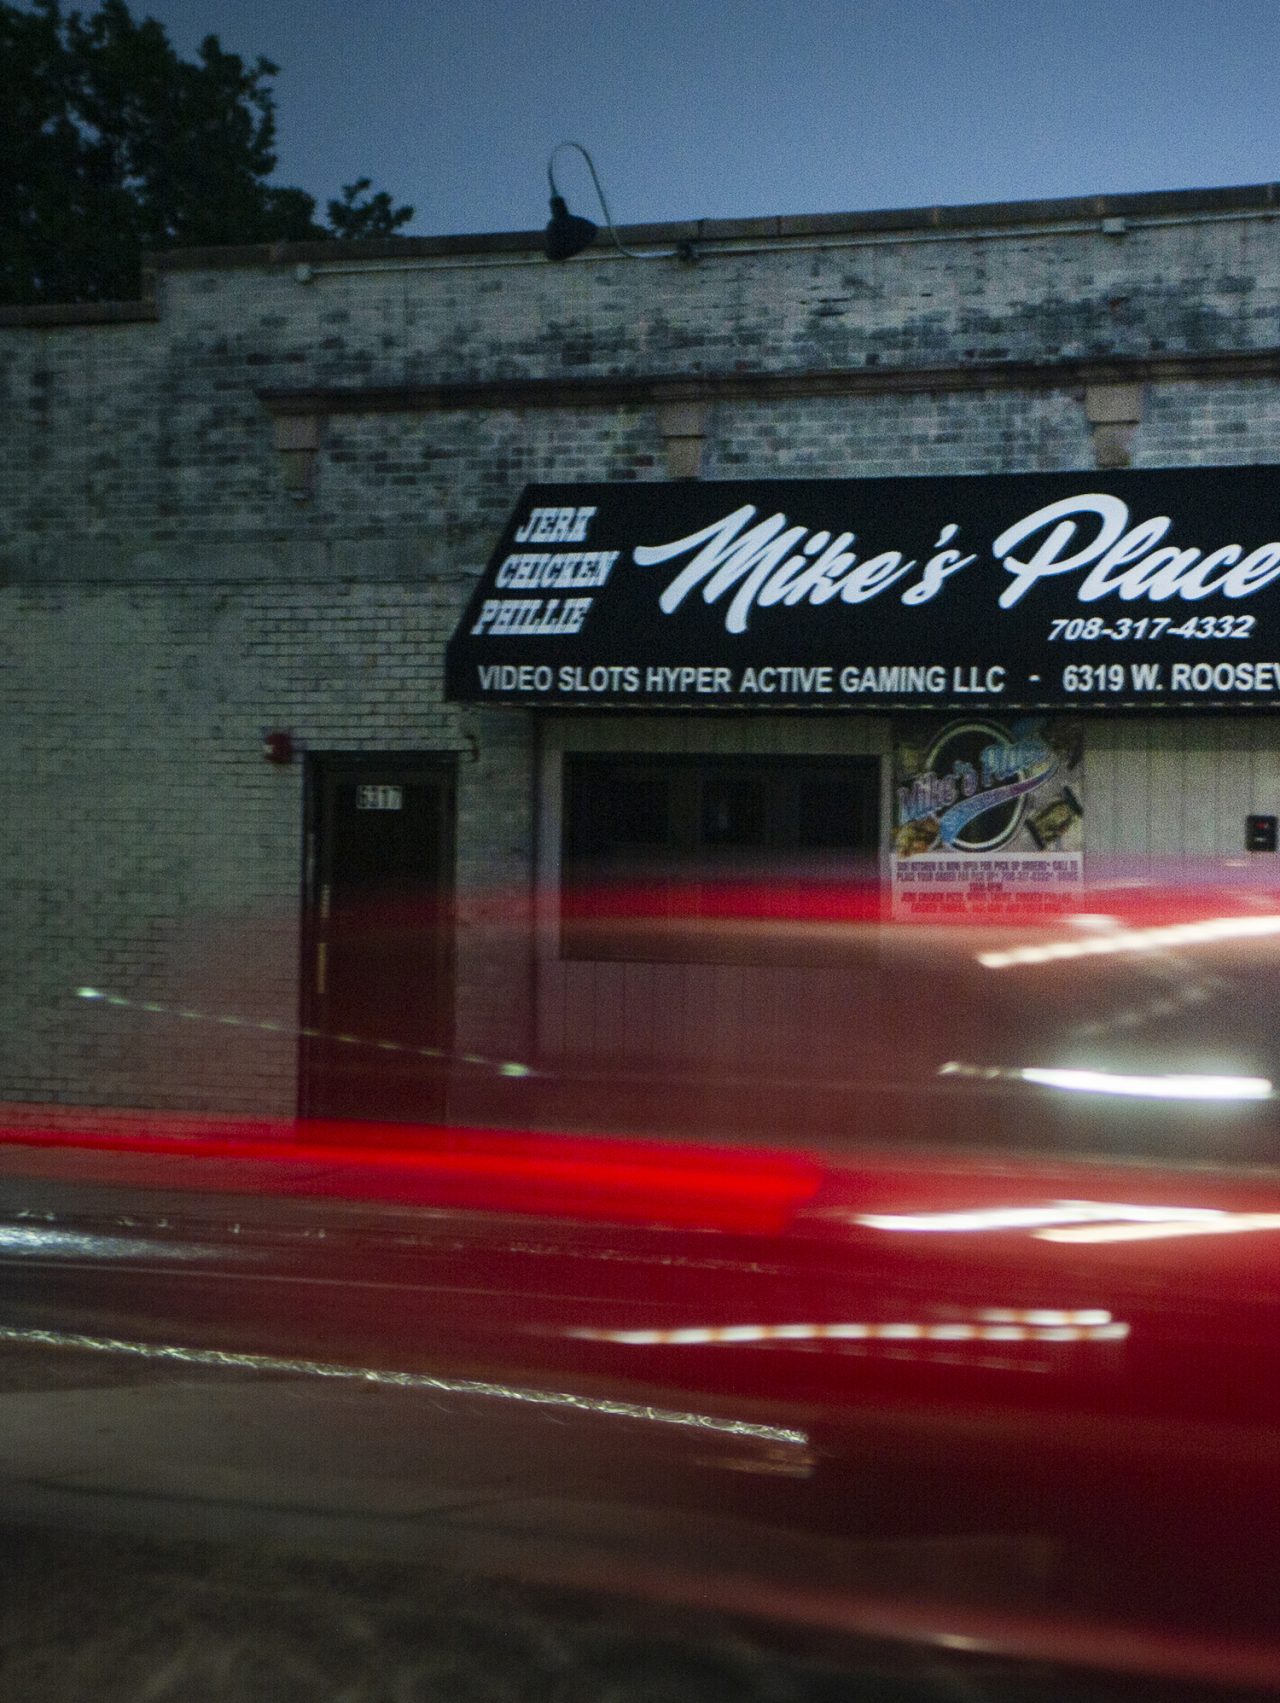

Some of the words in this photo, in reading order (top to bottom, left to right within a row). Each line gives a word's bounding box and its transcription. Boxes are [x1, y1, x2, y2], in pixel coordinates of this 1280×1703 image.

[515, 507, 597, 543] JERK
[496, 551, 620, 589] CHICKEN
[633, 504, 977, 634] Mike's
[471, 597, 593, 635] PHILLIE
[1048, 615, 1256, 641] 708-317-4332
[479, 666, 553, 691] VIDEO
[559, 666, 639, 692] SLOTS
[646, 667, 731, 693] HYPER
[740, 667, 833, 693] ACTIVE
[840, 666, 946, 693] GAMING
[953, 666, 1006, 693] LLC
[1063, 664, 1124, 692] 6319
[1131, 664, 1163, 691] W.
